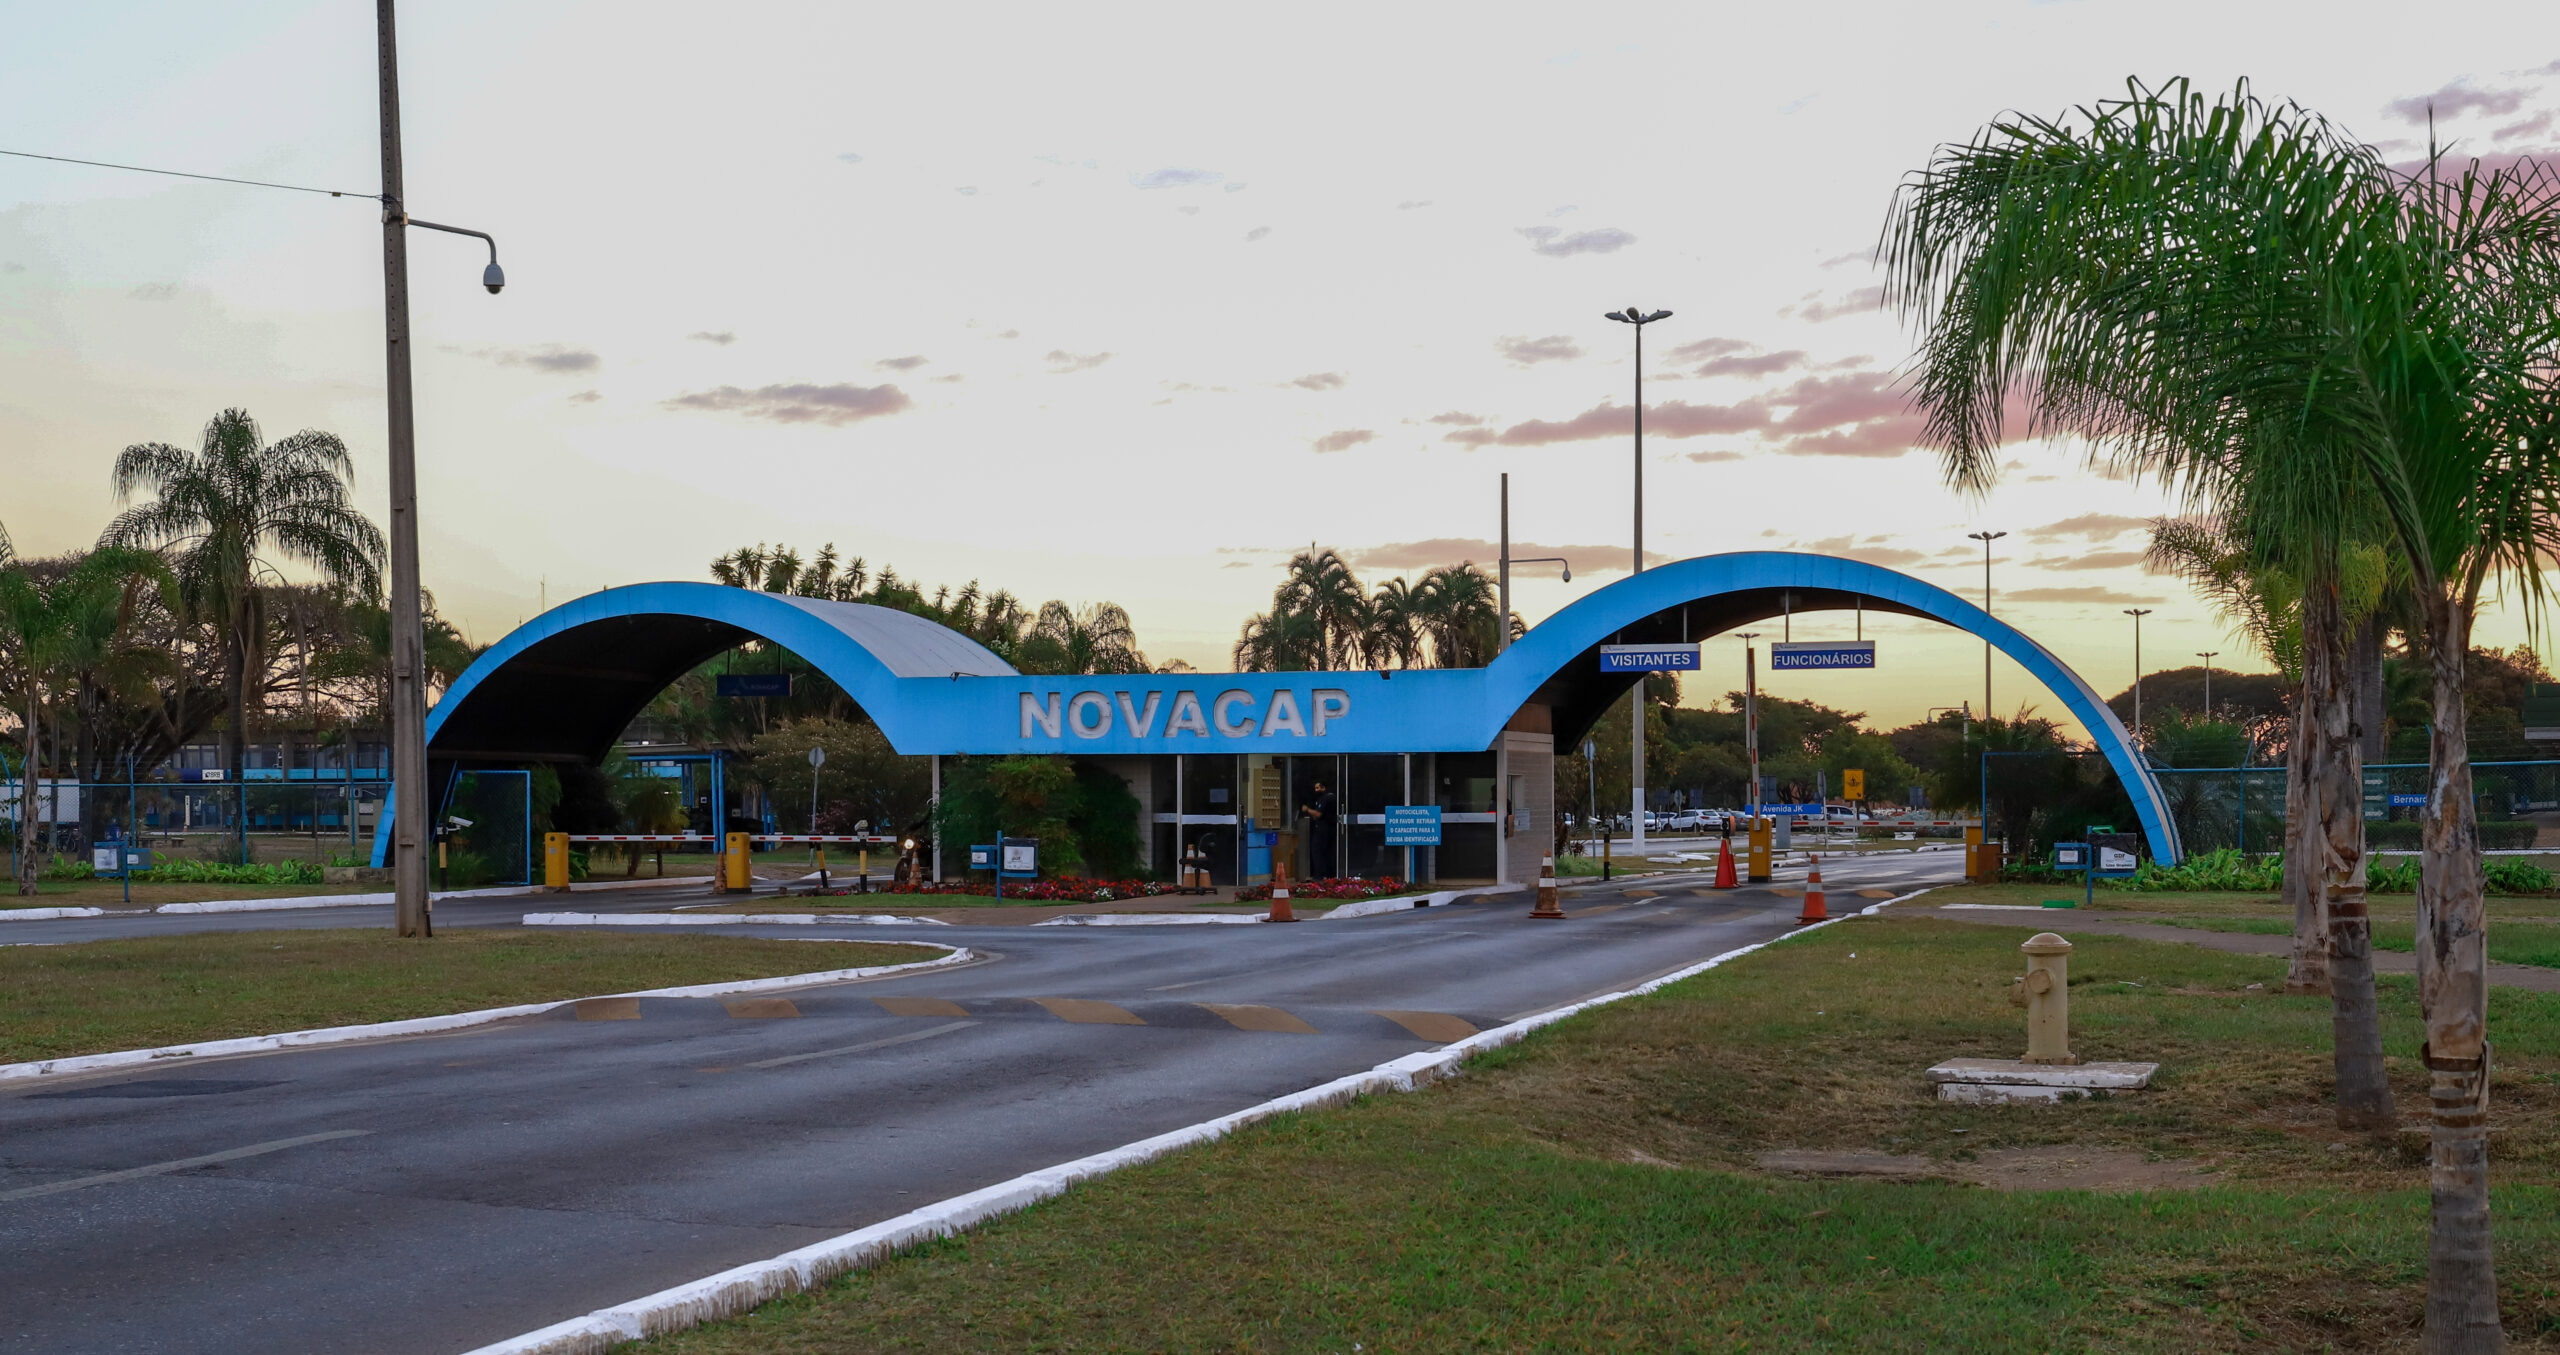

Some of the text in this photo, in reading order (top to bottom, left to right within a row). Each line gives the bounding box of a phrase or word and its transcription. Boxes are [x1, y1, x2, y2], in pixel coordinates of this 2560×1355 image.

[1610, 653, 1691, 667] VISITANTES
[1774, 652, 1872, 666] FUNCIONÁRIOS
[1019, 688, 1351, 739] NOVACAP
[1762, 805, 1804, 813] Avenida JK
[1404, 835, 1439, 843] IDENTIFICAÇÃO
